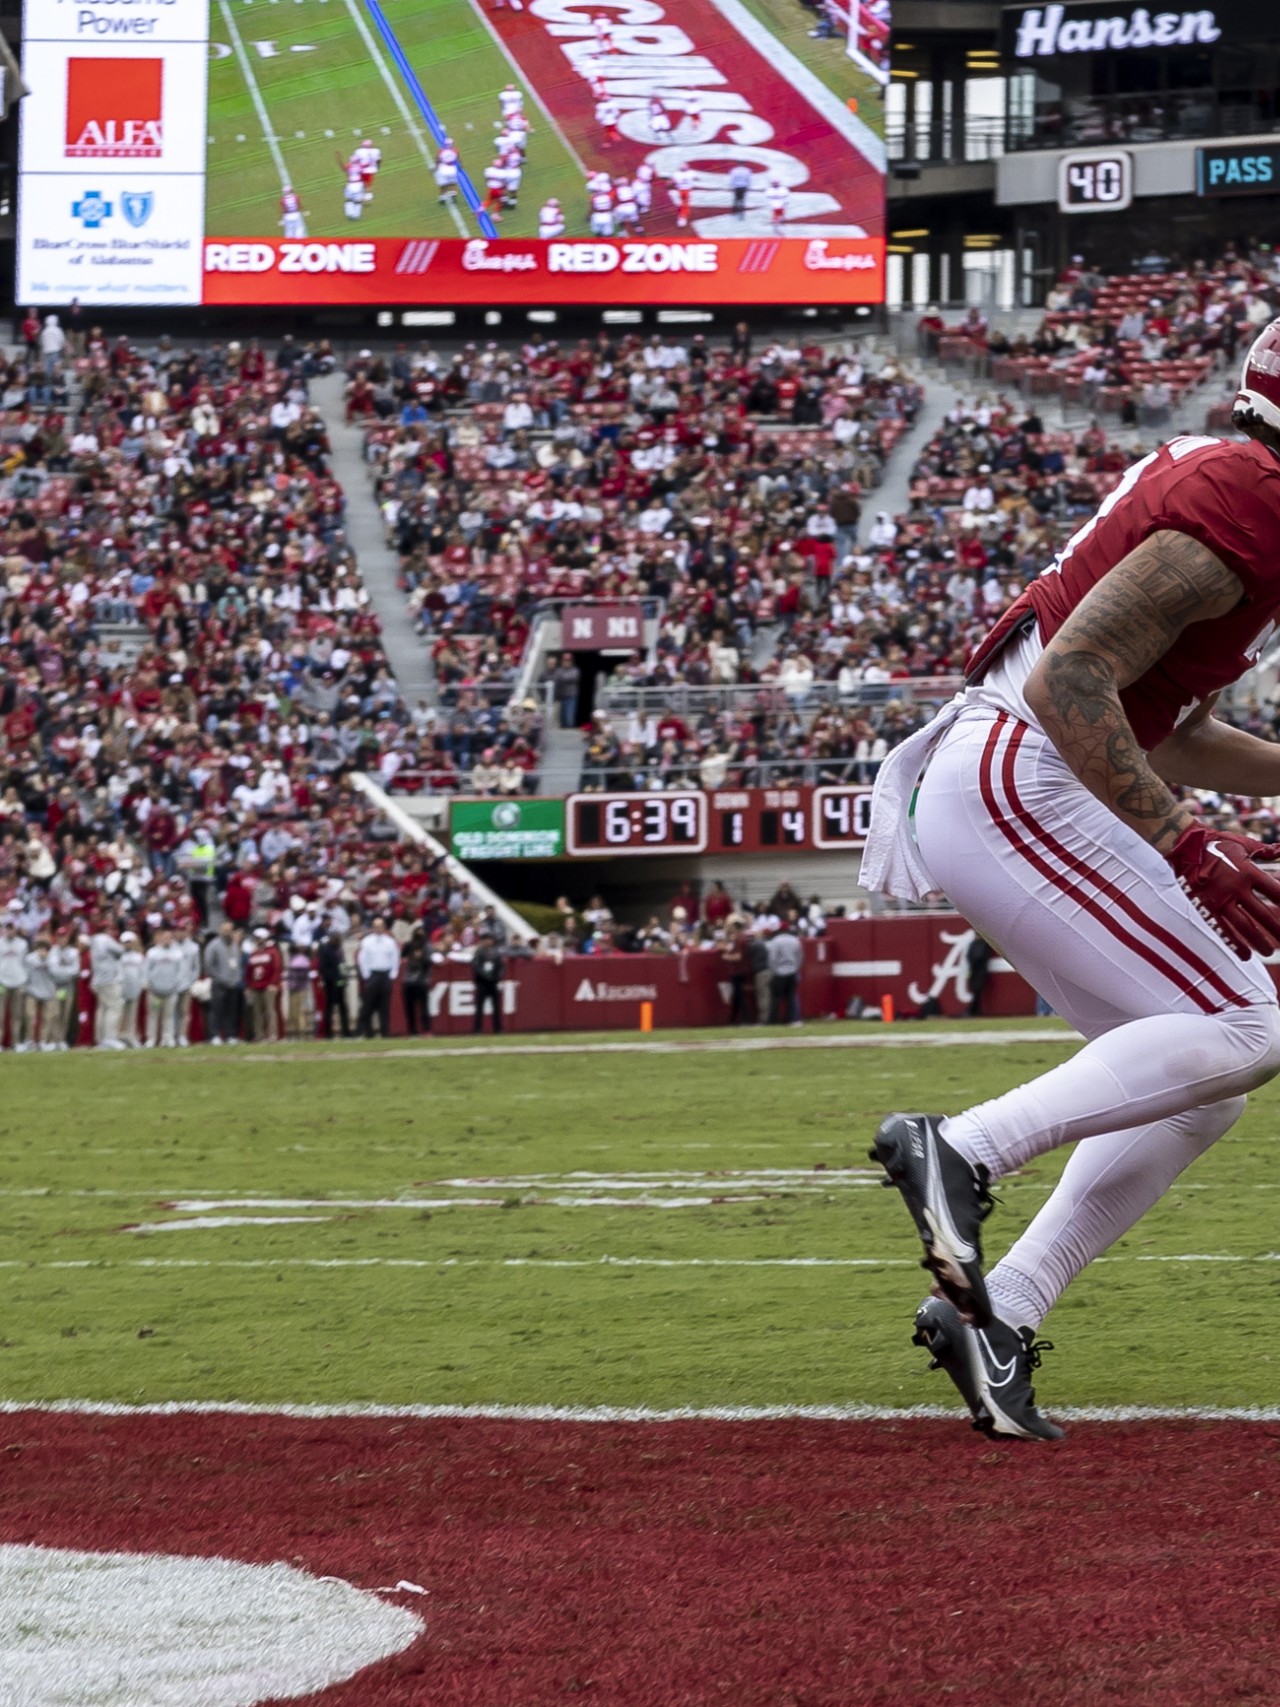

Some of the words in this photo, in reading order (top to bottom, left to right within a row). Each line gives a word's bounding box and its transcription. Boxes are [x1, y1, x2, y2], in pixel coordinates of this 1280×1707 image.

[78, 10, 158, 33] Power
[1015, 4, 1222, 57] Hansen
[75, 119, 163, 145] ALFA
[1069, 161, 1120, 201] 40
[1209, 156, 1272, 184] PASS
[205, 243, 276, 273] RED
[278, 243, 376, 273] ZONE
[547, 243, 619, 272] RED
[621, 243, 719, 272] ZONE
[572, 618, 593, 639] N
[607, 616, 639, 638] N1
[605, 799, 697, 843] 6:39
[732, 813, 743, 844] 1
[782, 811, 805, 842] 4
